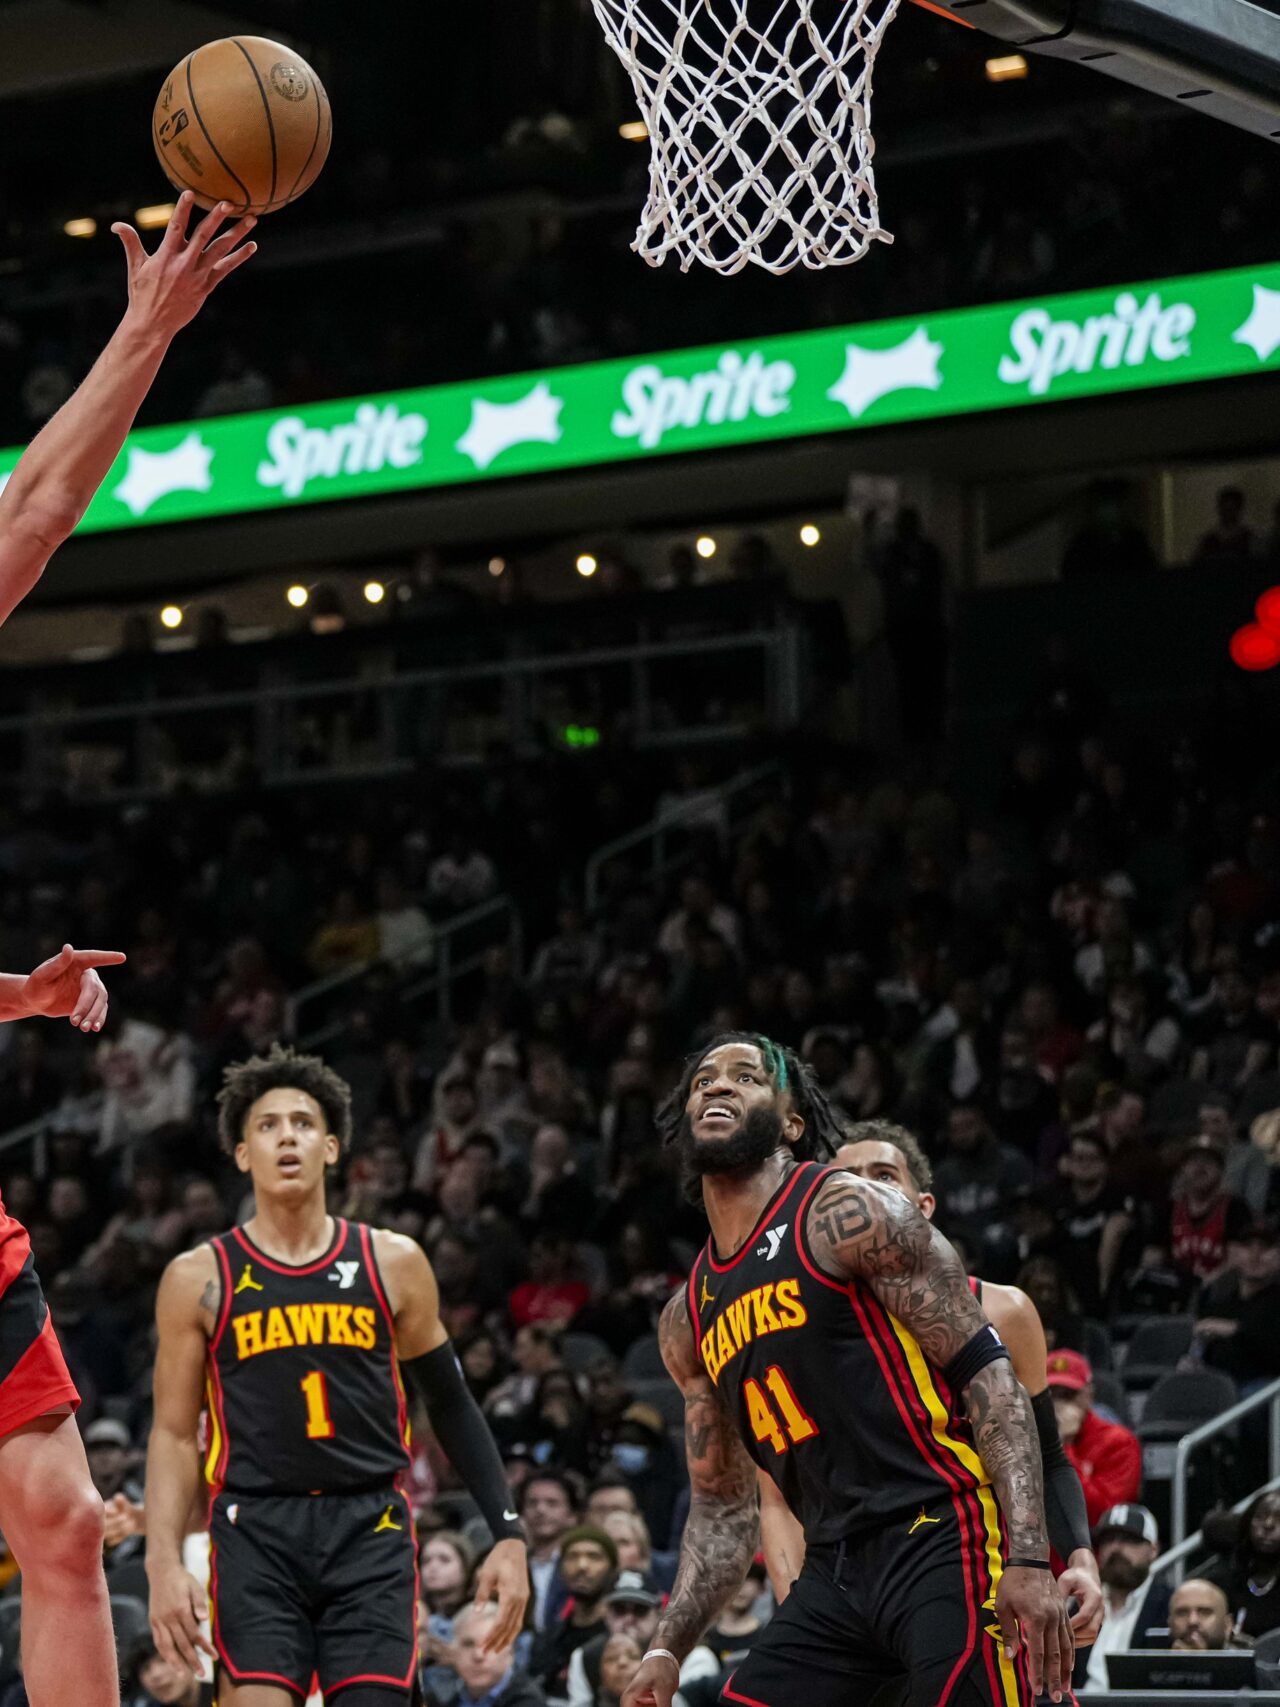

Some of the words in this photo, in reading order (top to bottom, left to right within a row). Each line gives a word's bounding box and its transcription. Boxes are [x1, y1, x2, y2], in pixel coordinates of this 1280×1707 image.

[256, 403, 428, 498] Sprite
[611, 350, 796, 448] Sprite
[998, 293, 1197, 394] Sprite
[231, 1303, 377, 1361] HAWKS
[700, 1277, 809, 1389] HAWKS
[299, 1370, 336, 1439] 1
[743, 1364, 820, 1456] 41
